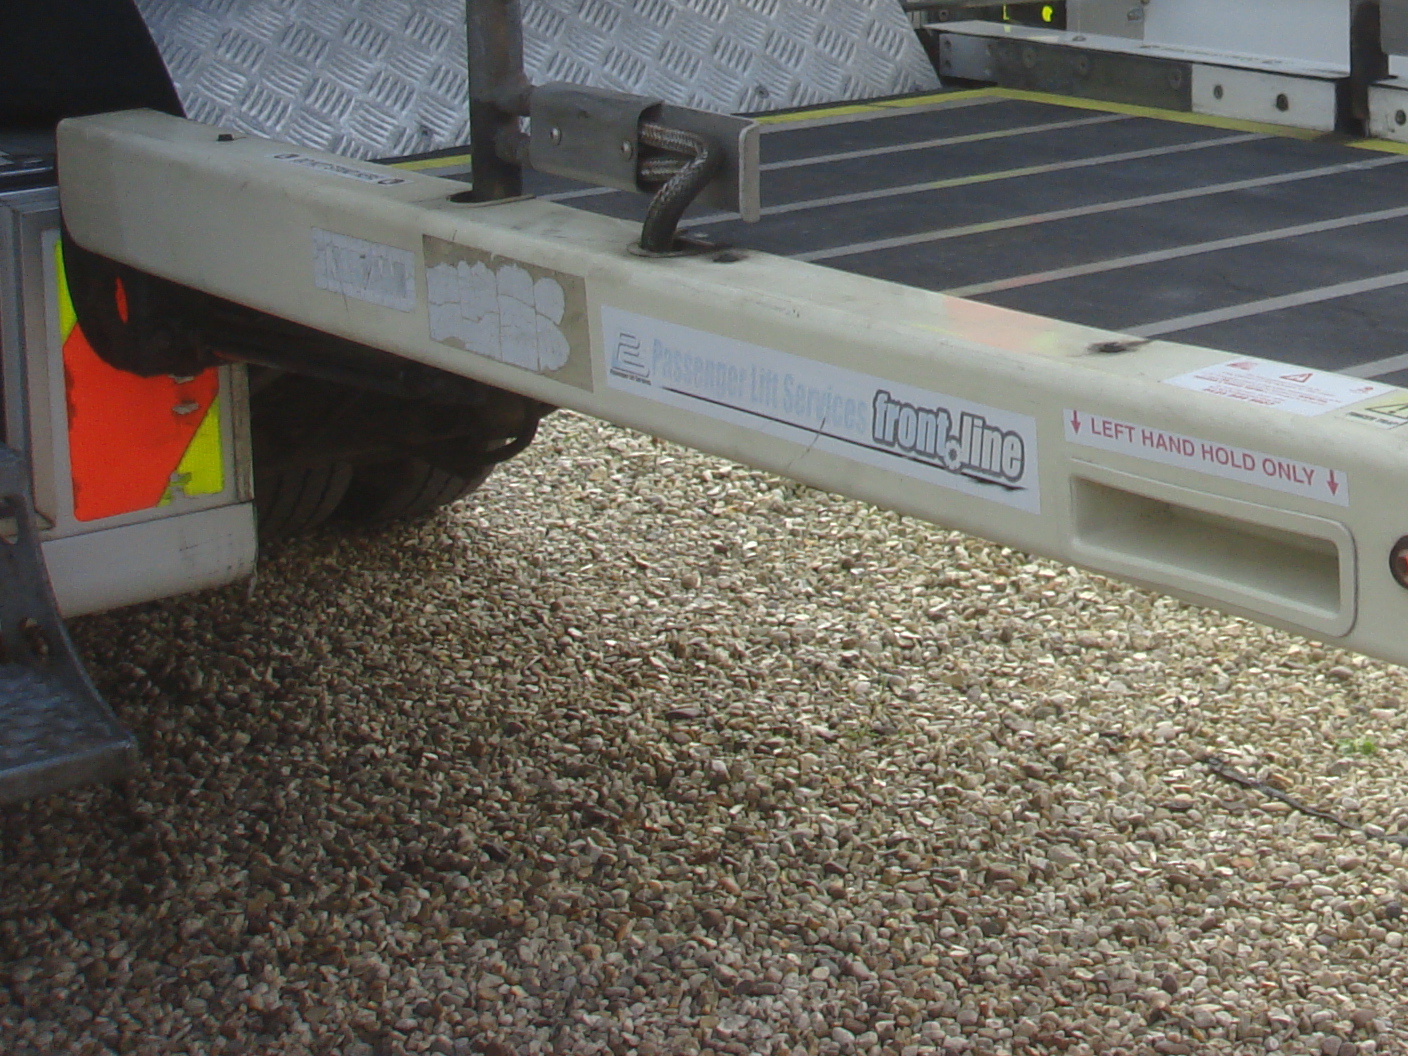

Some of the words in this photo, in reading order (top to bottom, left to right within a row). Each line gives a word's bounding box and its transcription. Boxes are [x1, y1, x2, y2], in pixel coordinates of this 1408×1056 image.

[1090, 417, 1135, 443] LEFT
[1141, 428, 1195, 457] HAND
[1201, 443, 1256, 472] HOLD
[1261, 458, 1316, 486] ONLY
